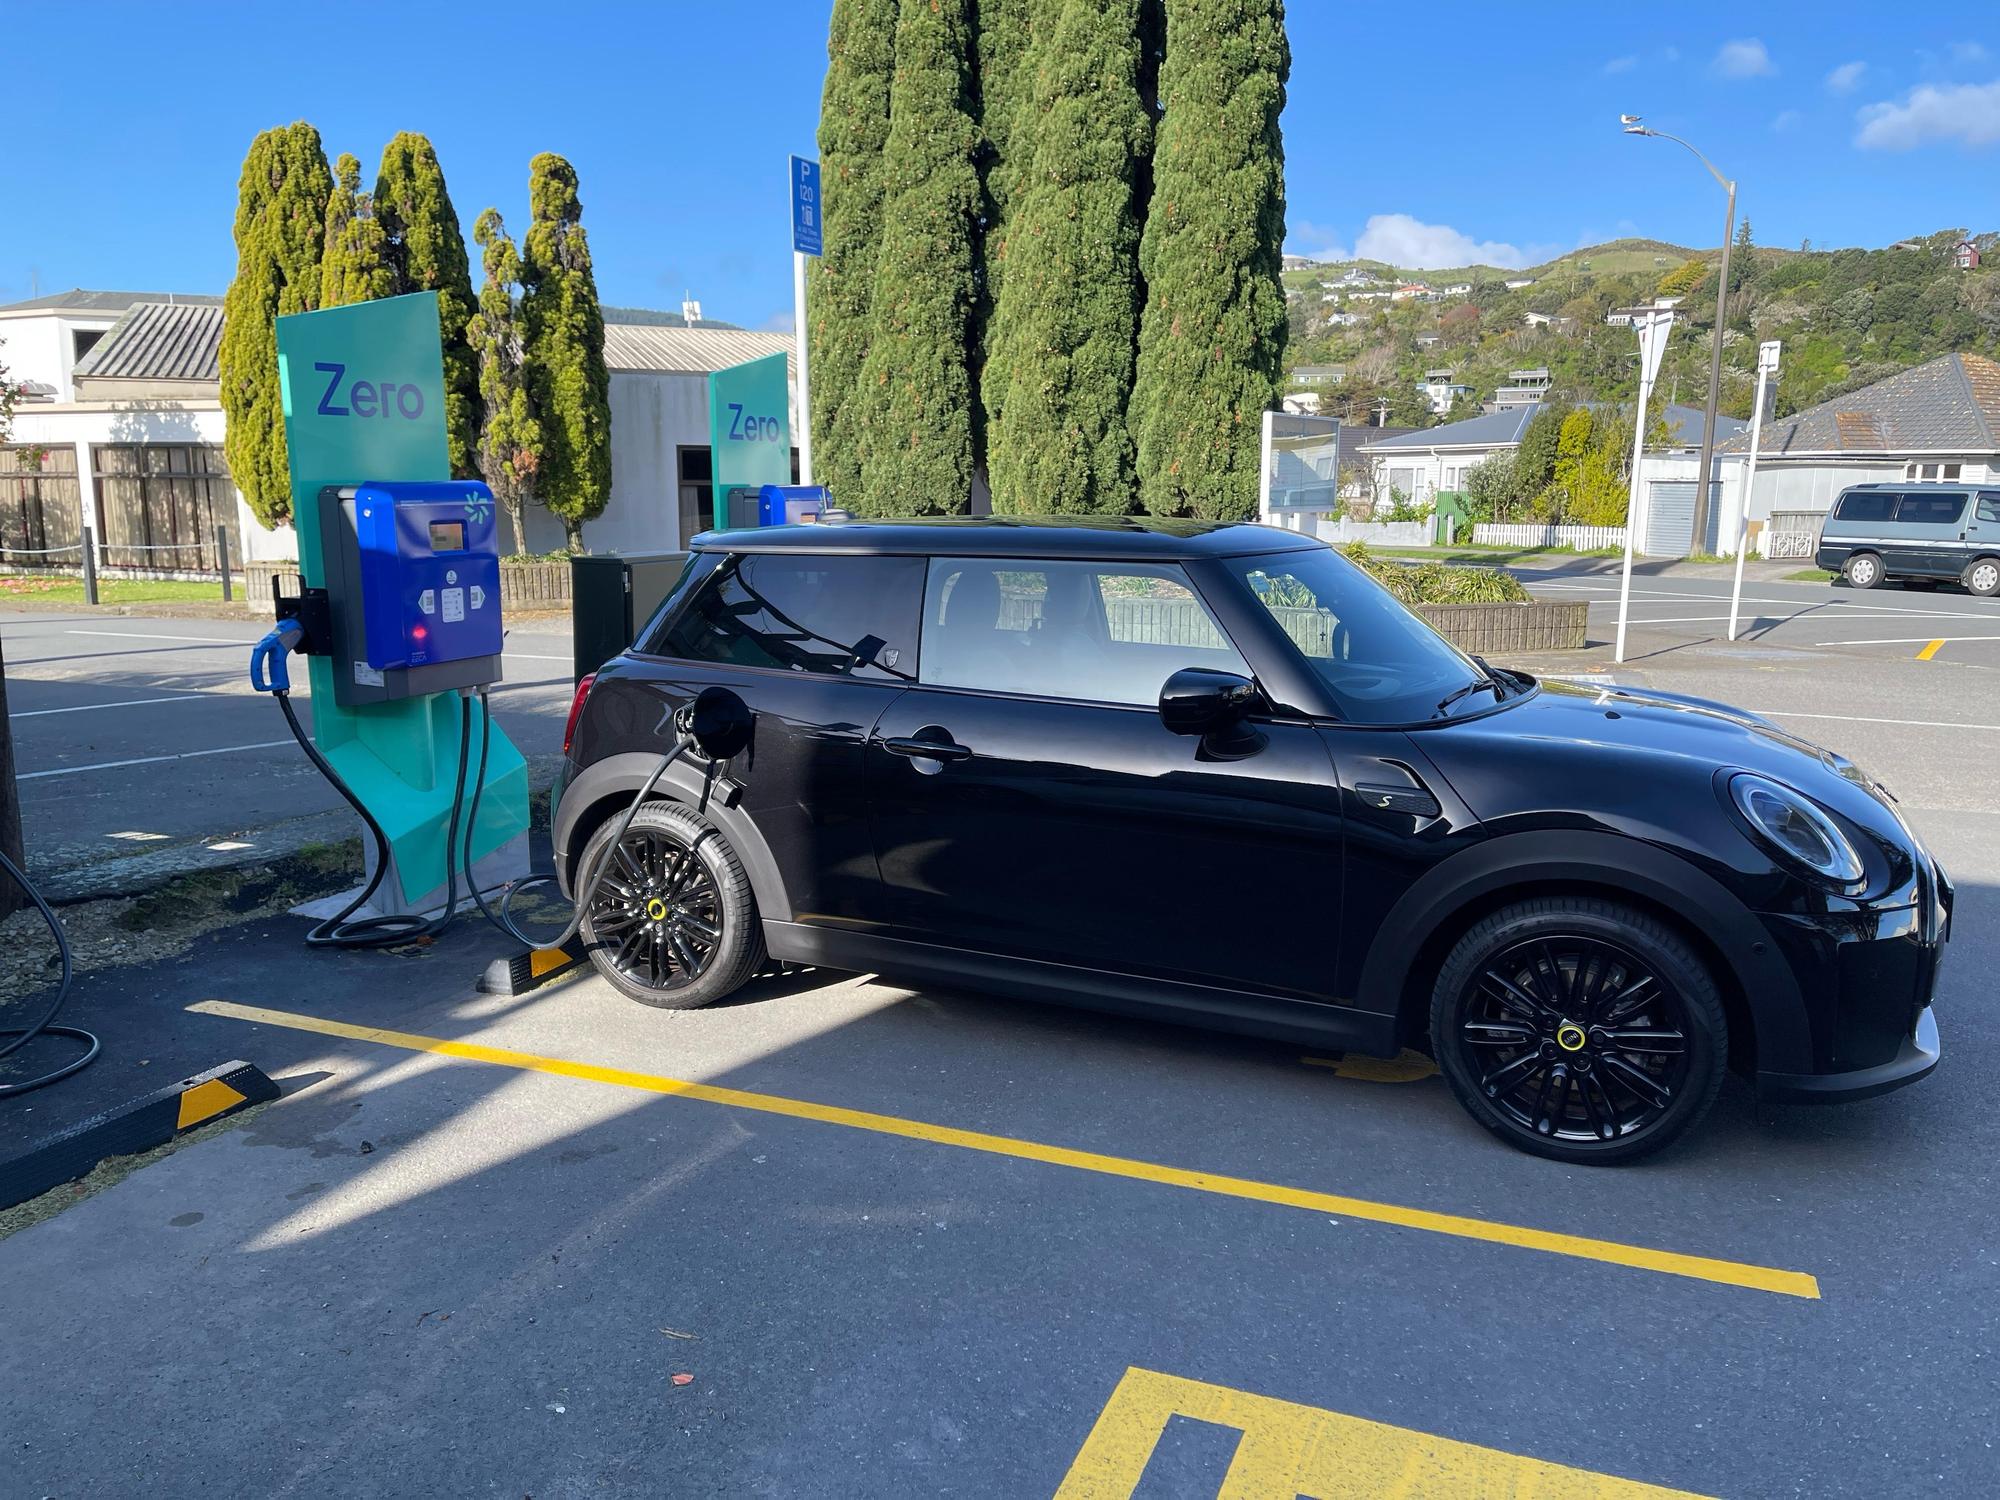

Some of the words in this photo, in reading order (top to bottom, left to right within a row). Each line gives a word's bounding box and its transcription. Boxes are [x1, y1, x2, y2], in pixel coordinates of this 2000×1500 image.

[801, 162, 810, 181] P
[800, 185, 813, 203] 120
[315, 362, 424, 420] Zero
[729, 403, 779, 442] Zero
[1377, 796, 1393, 807] S
